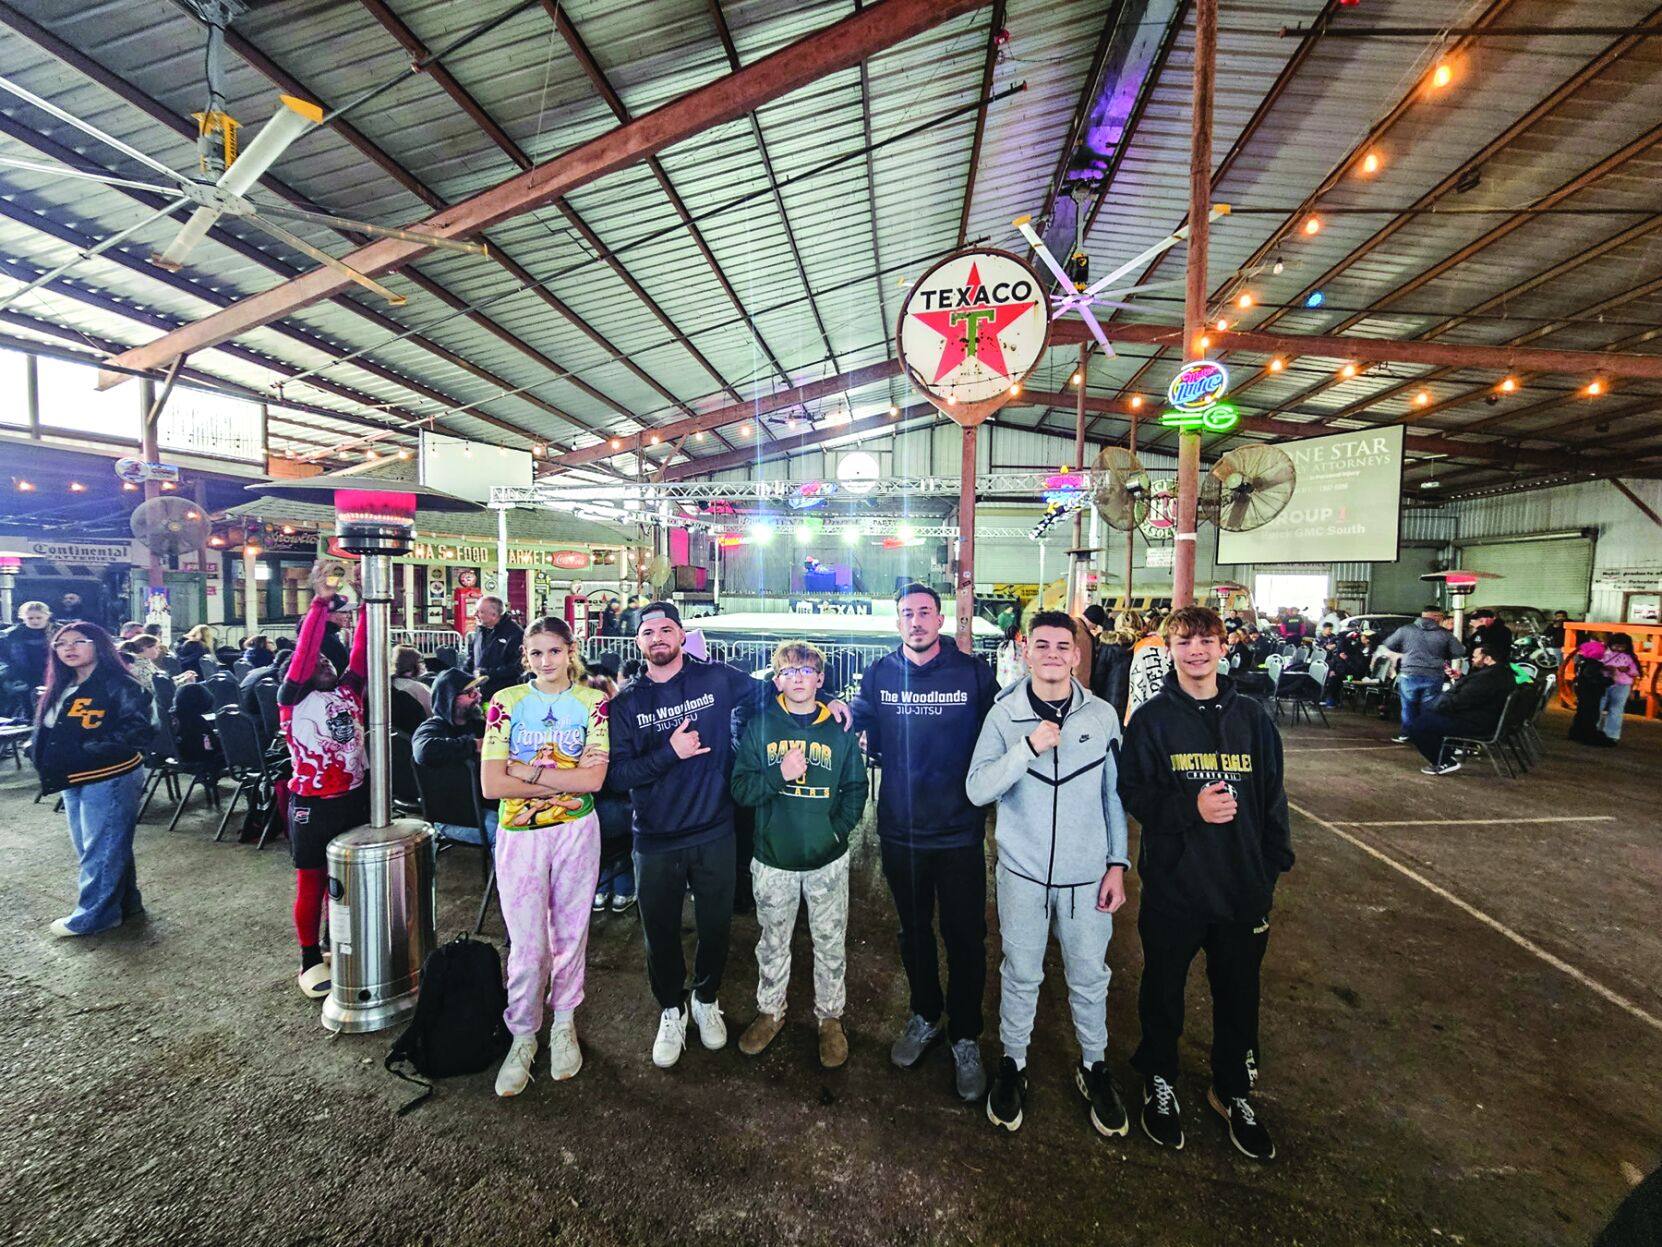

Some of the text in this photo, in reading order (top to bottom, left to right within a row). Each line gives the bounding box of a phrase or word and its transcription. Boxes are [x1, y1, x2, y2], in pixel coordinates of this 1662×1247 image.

[920, 281, 1032, 310] TEXACO
[1331, 438, 1389, 461] STAR
[1313, 454, 1391, 472] ATTORNEYS
[1274, 508, 1333, 525] ROUP
[1327, 524, 1366, 536] South
[33, 543, 128, 557] Continental
[456, 545, 489, 563] FOOD
[508, 551, 546, 565] ARKET
[880, 689, 968, 703] The Woodlands
[636, 693, 715, 726] The Woodlands
[896, 706, 943, 715] JIU-JITSU
